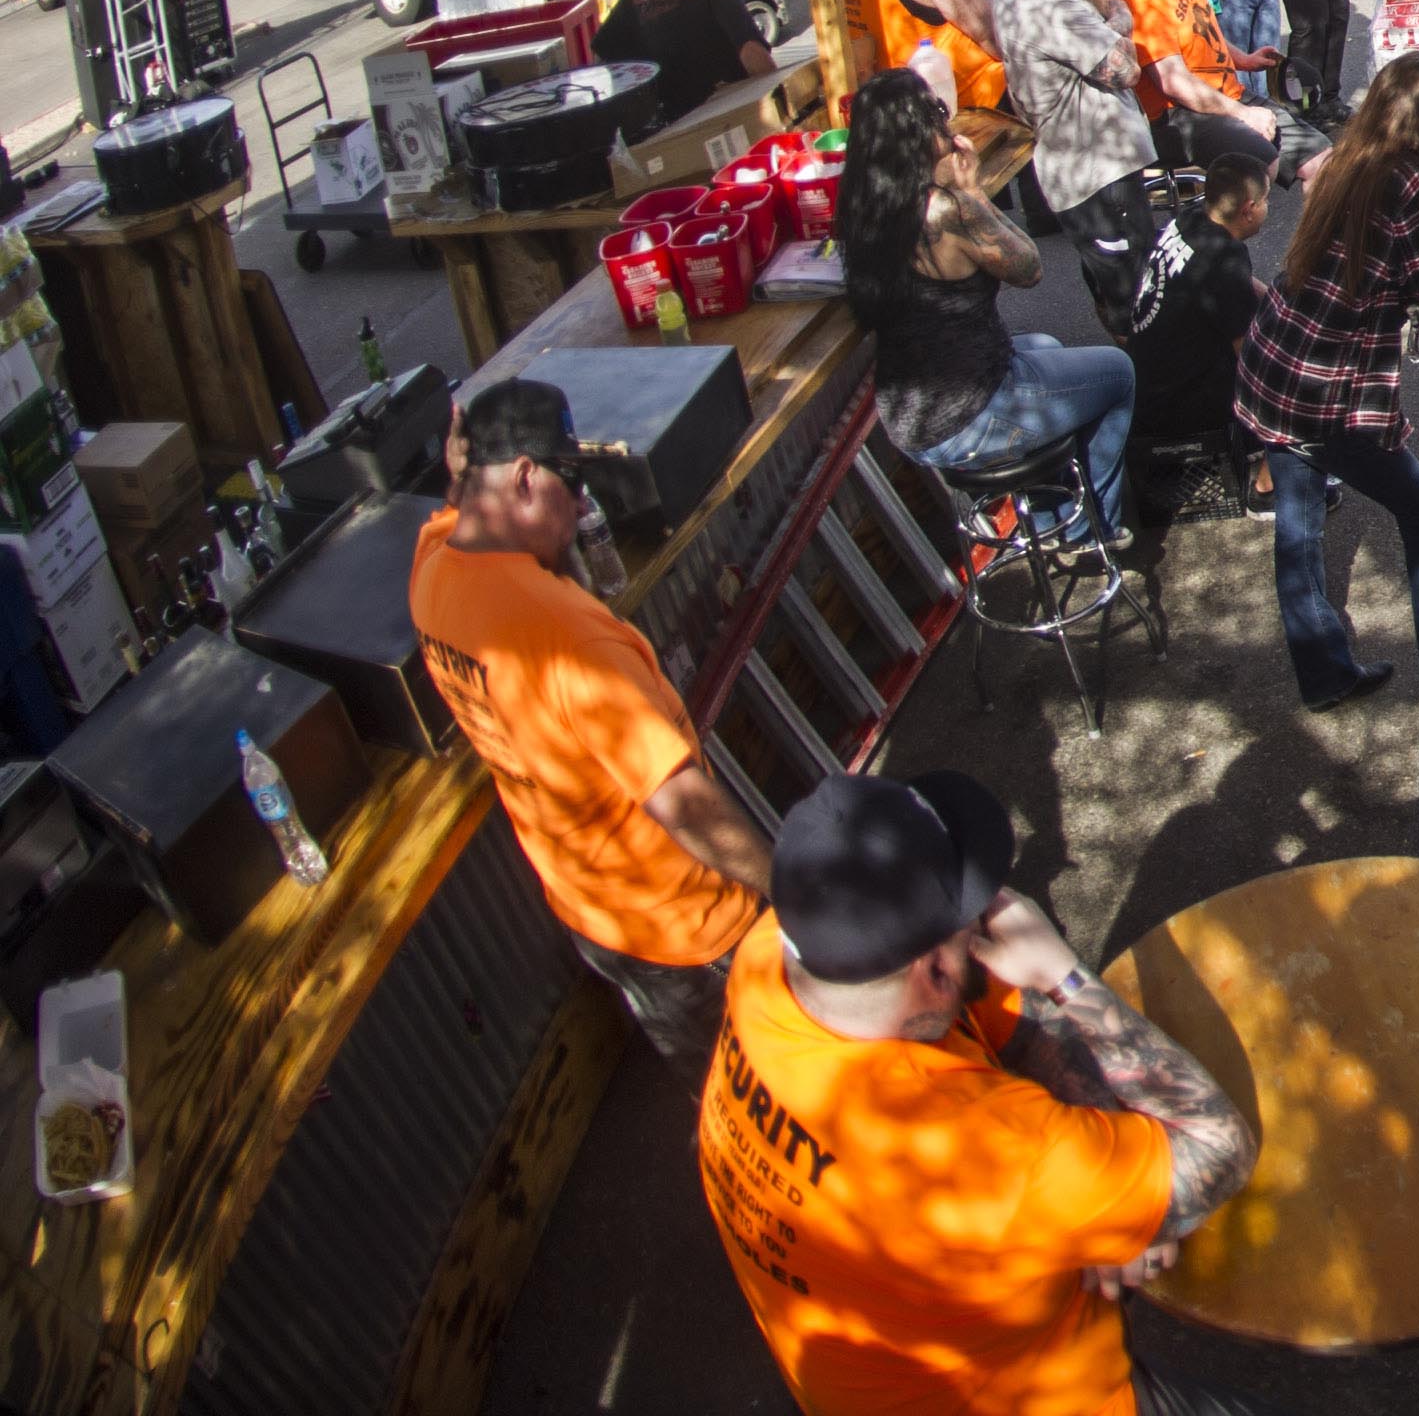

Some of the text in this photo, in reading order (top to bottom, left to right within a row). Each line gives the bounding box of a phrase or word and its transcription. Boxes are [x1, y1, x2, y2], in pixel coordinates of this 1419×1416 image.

[713, 1089, 805, 1208] REQUIRED
[736, 1180, 774, 1226] RIGHT
[777, 1217, 798, 1245] TO
[738, 1207, 788, 1261] TO YOU
